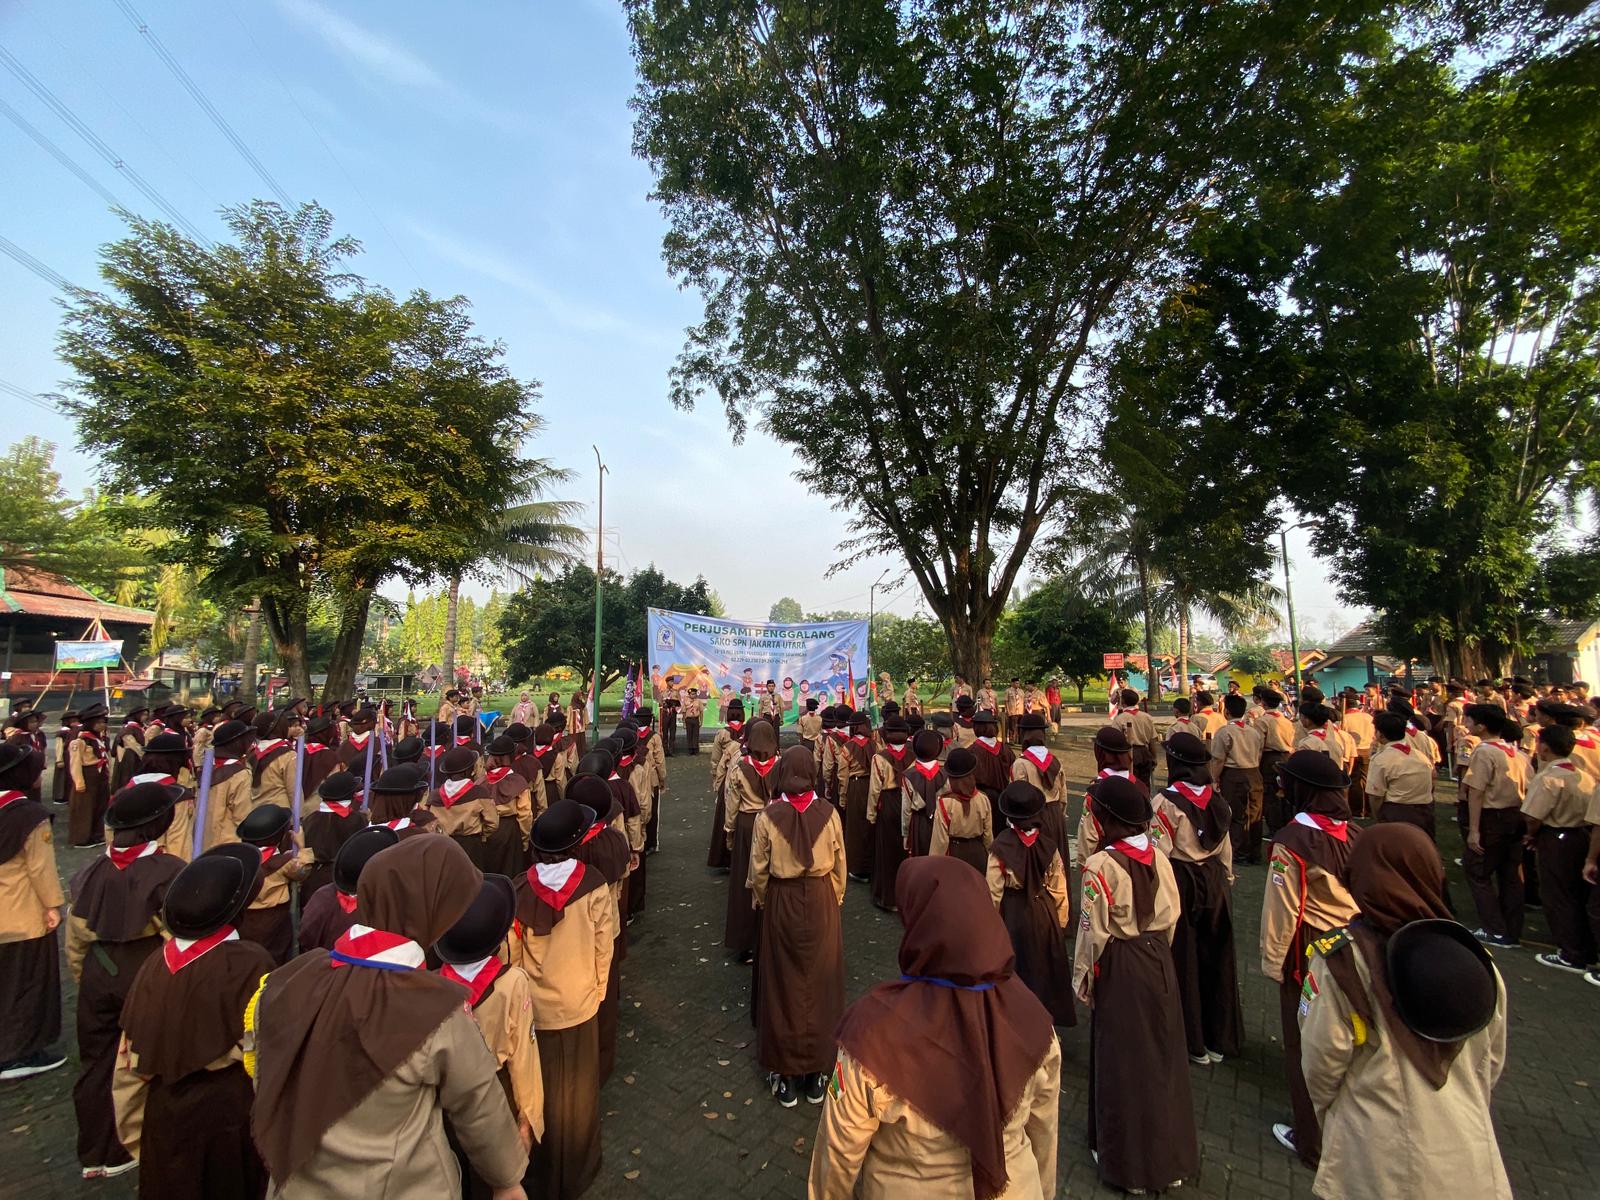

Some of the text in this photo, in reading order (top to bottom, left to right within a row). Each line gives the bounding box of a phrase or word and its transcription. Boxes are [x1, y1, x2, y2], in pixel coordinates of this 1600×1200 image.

[684, 622, 835, 639] PERJUSAMI PENGGALANG
[710, 637, 807, 650] SAKO SPN JAKARTA UTARA
